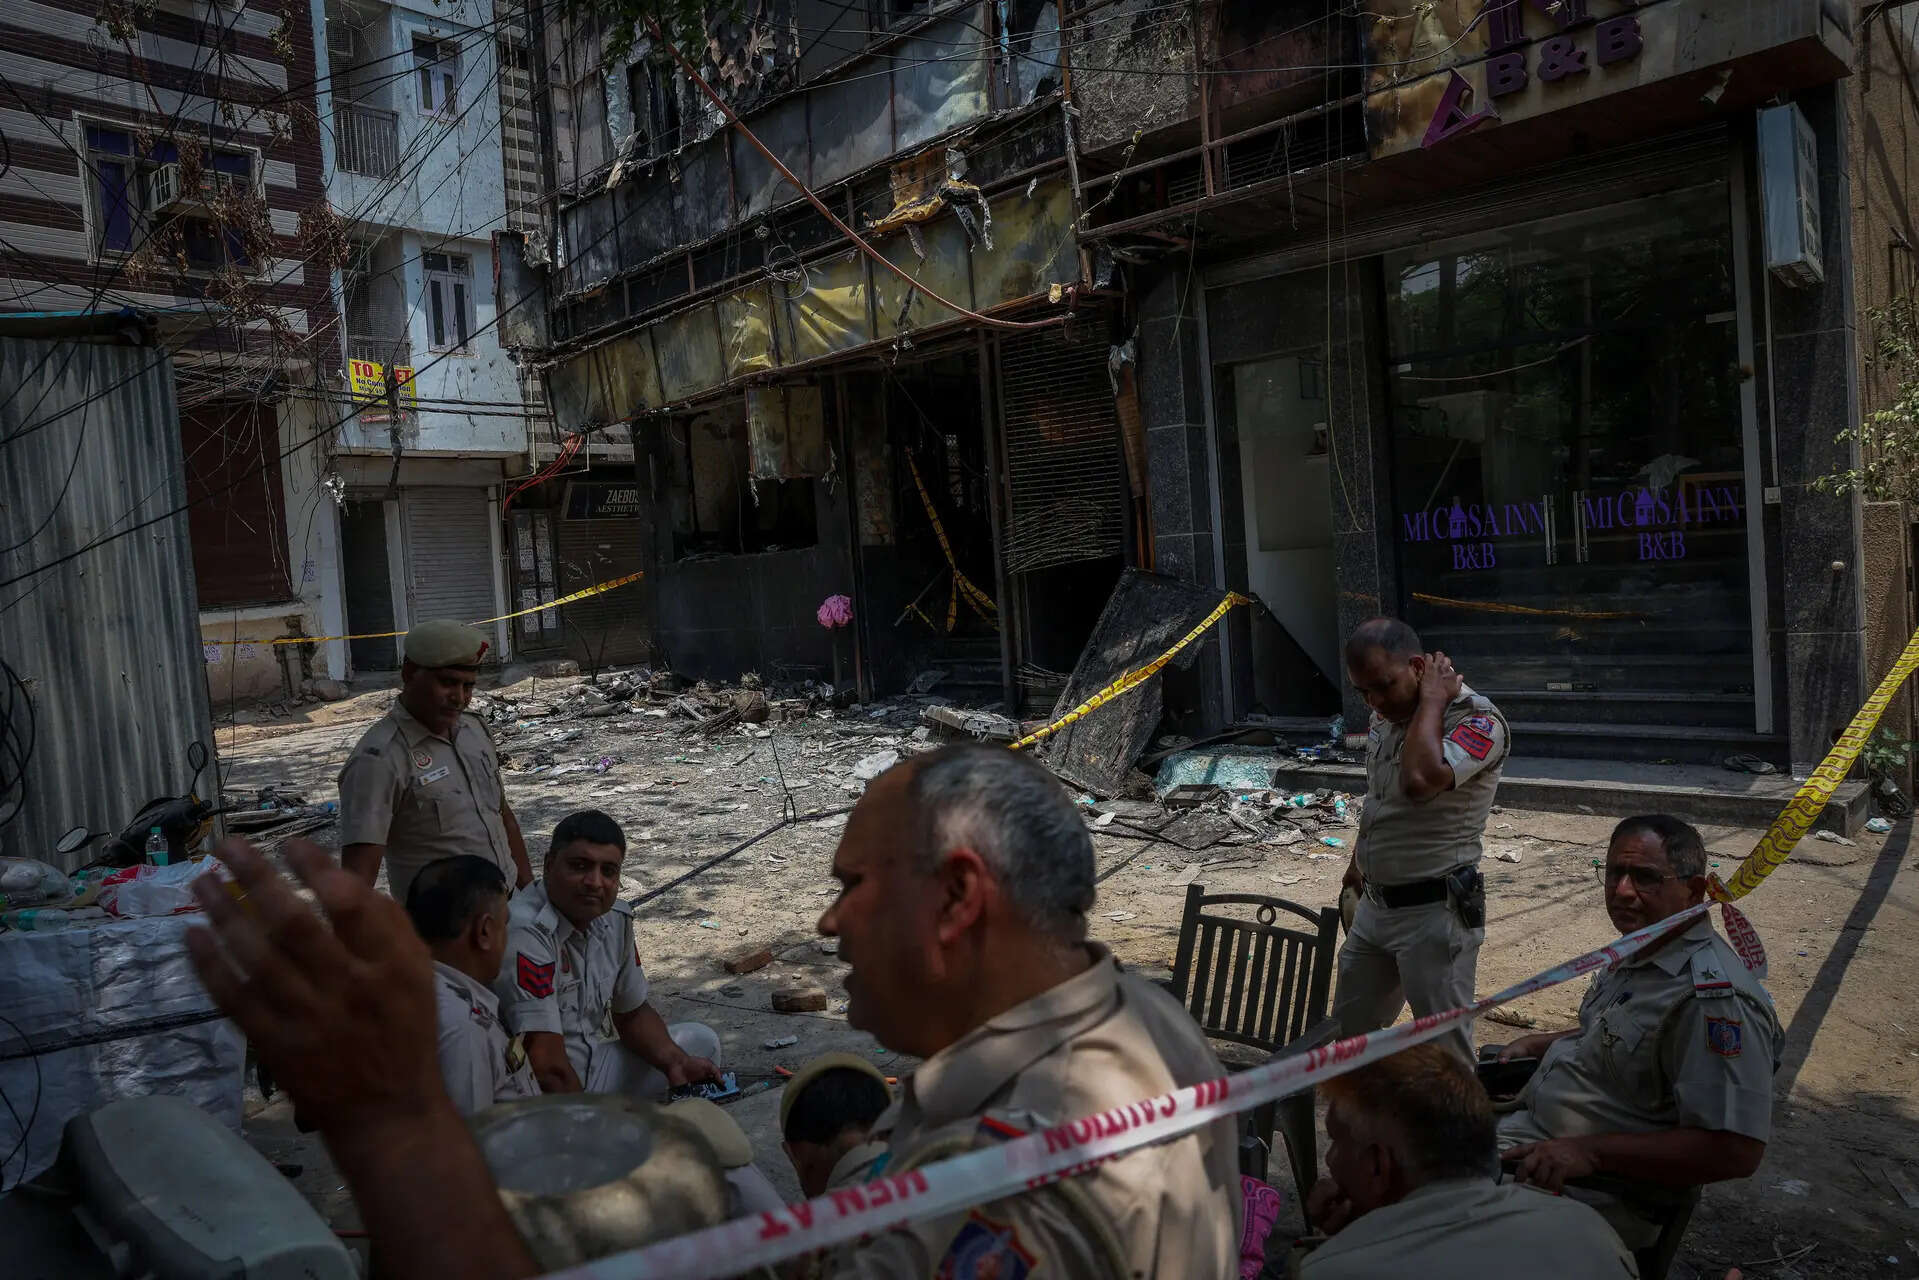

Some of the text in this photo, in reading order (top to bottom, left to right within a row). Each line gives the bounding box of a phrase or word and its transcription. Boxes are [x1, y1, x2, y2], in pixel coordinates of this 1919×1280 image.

[1486, 16, 1643, 98] B&B
[351, 361, 374, 378] TO
[394, 368, 412, 384] ET
[1585, 495, 1616, 529] MI
[1695, 487, 1742, 523] INN
[1402, 511, 1431, 542] MI
[1451, 542, 1497, 571] B&B
[1639, 530, 1688, 561] B&B
[760, 1201, 814, 1241] AT
